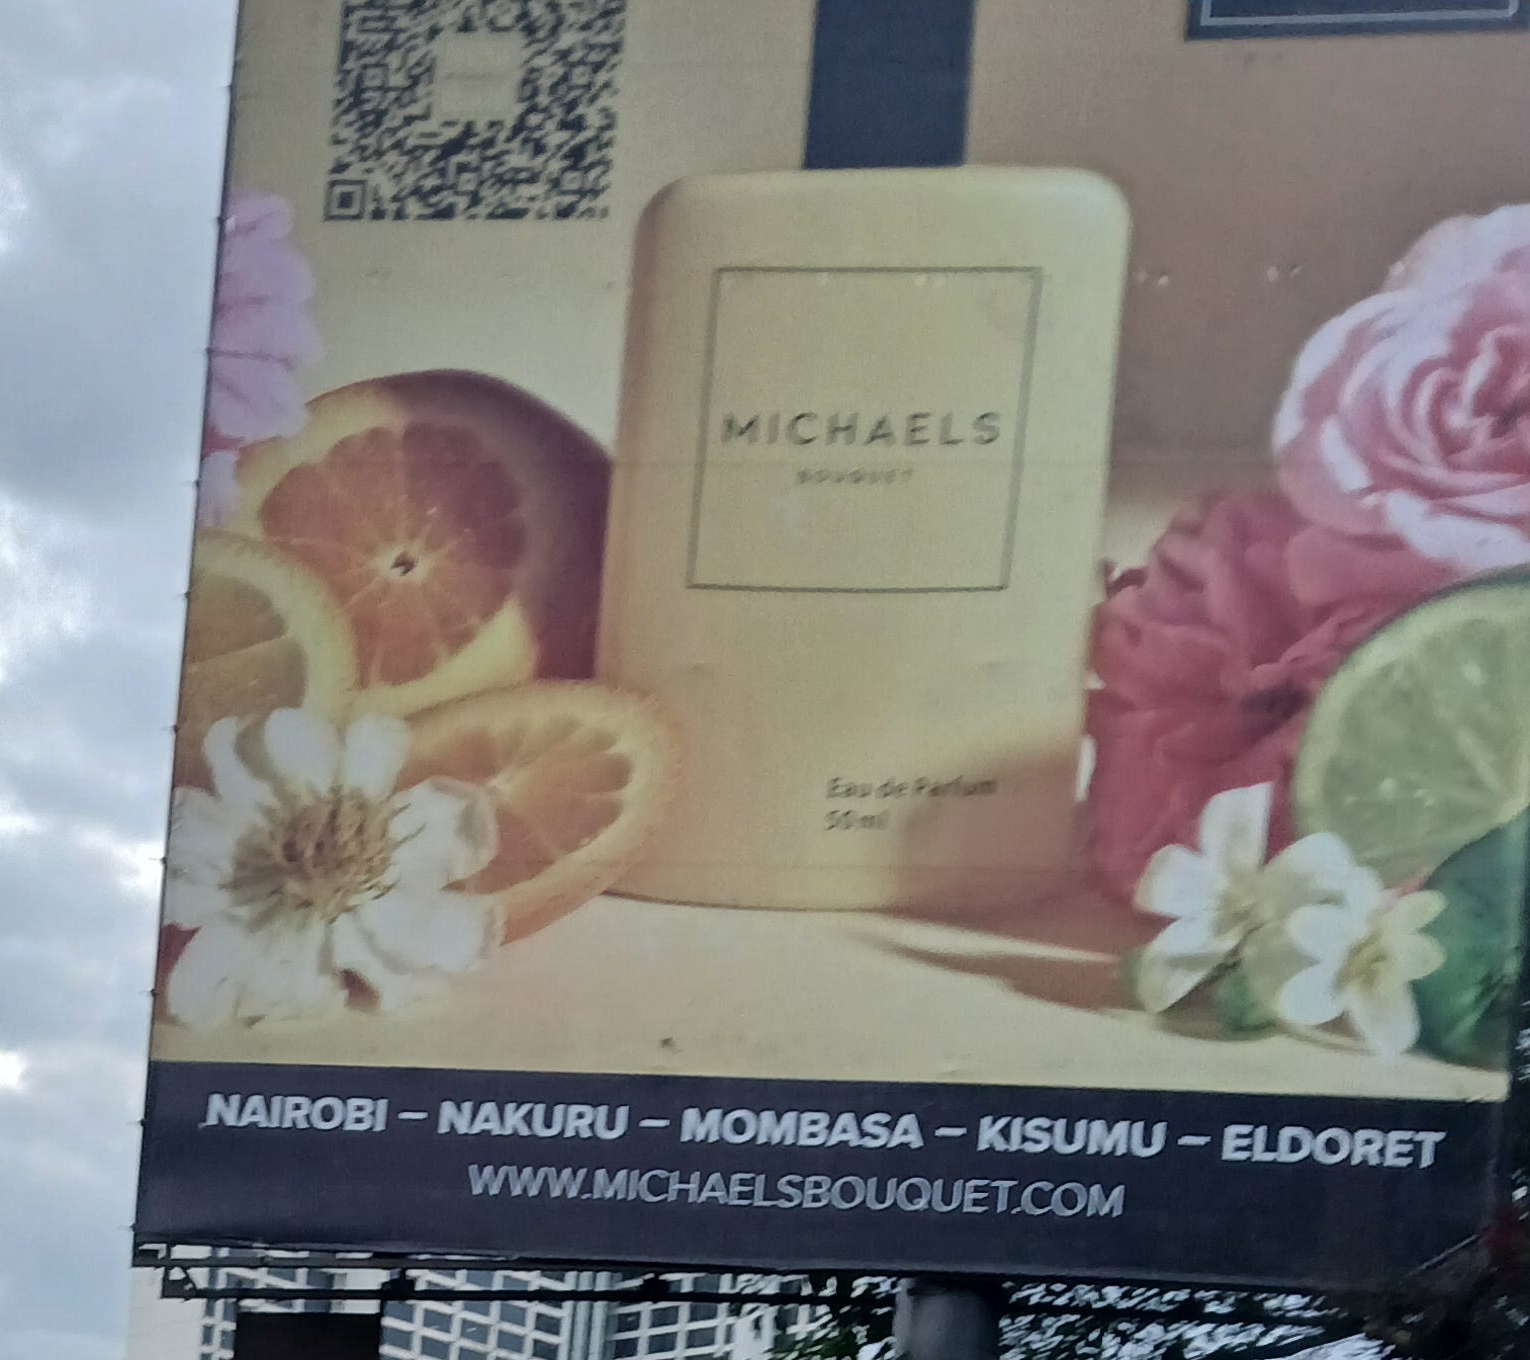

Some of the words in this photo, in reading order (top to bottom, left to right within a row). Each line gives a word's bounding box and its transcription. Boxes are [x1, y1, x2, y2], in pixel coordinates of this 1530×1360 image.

[720, 411, 1002, 445] MICHAELS
[203, 1094, 388, 1132] NAIROBI
[437, 1101, 630, 1140] NAKURU
[680, 1108, 924, 1149] MOMBASA
[976, 1115, 1167, 1159] KISUMU
[1221, 1124, 1446, 1169] ELDORET
[469, 1164, 1125, 1218] WWW.MICHAELSBOUQUET.COM
